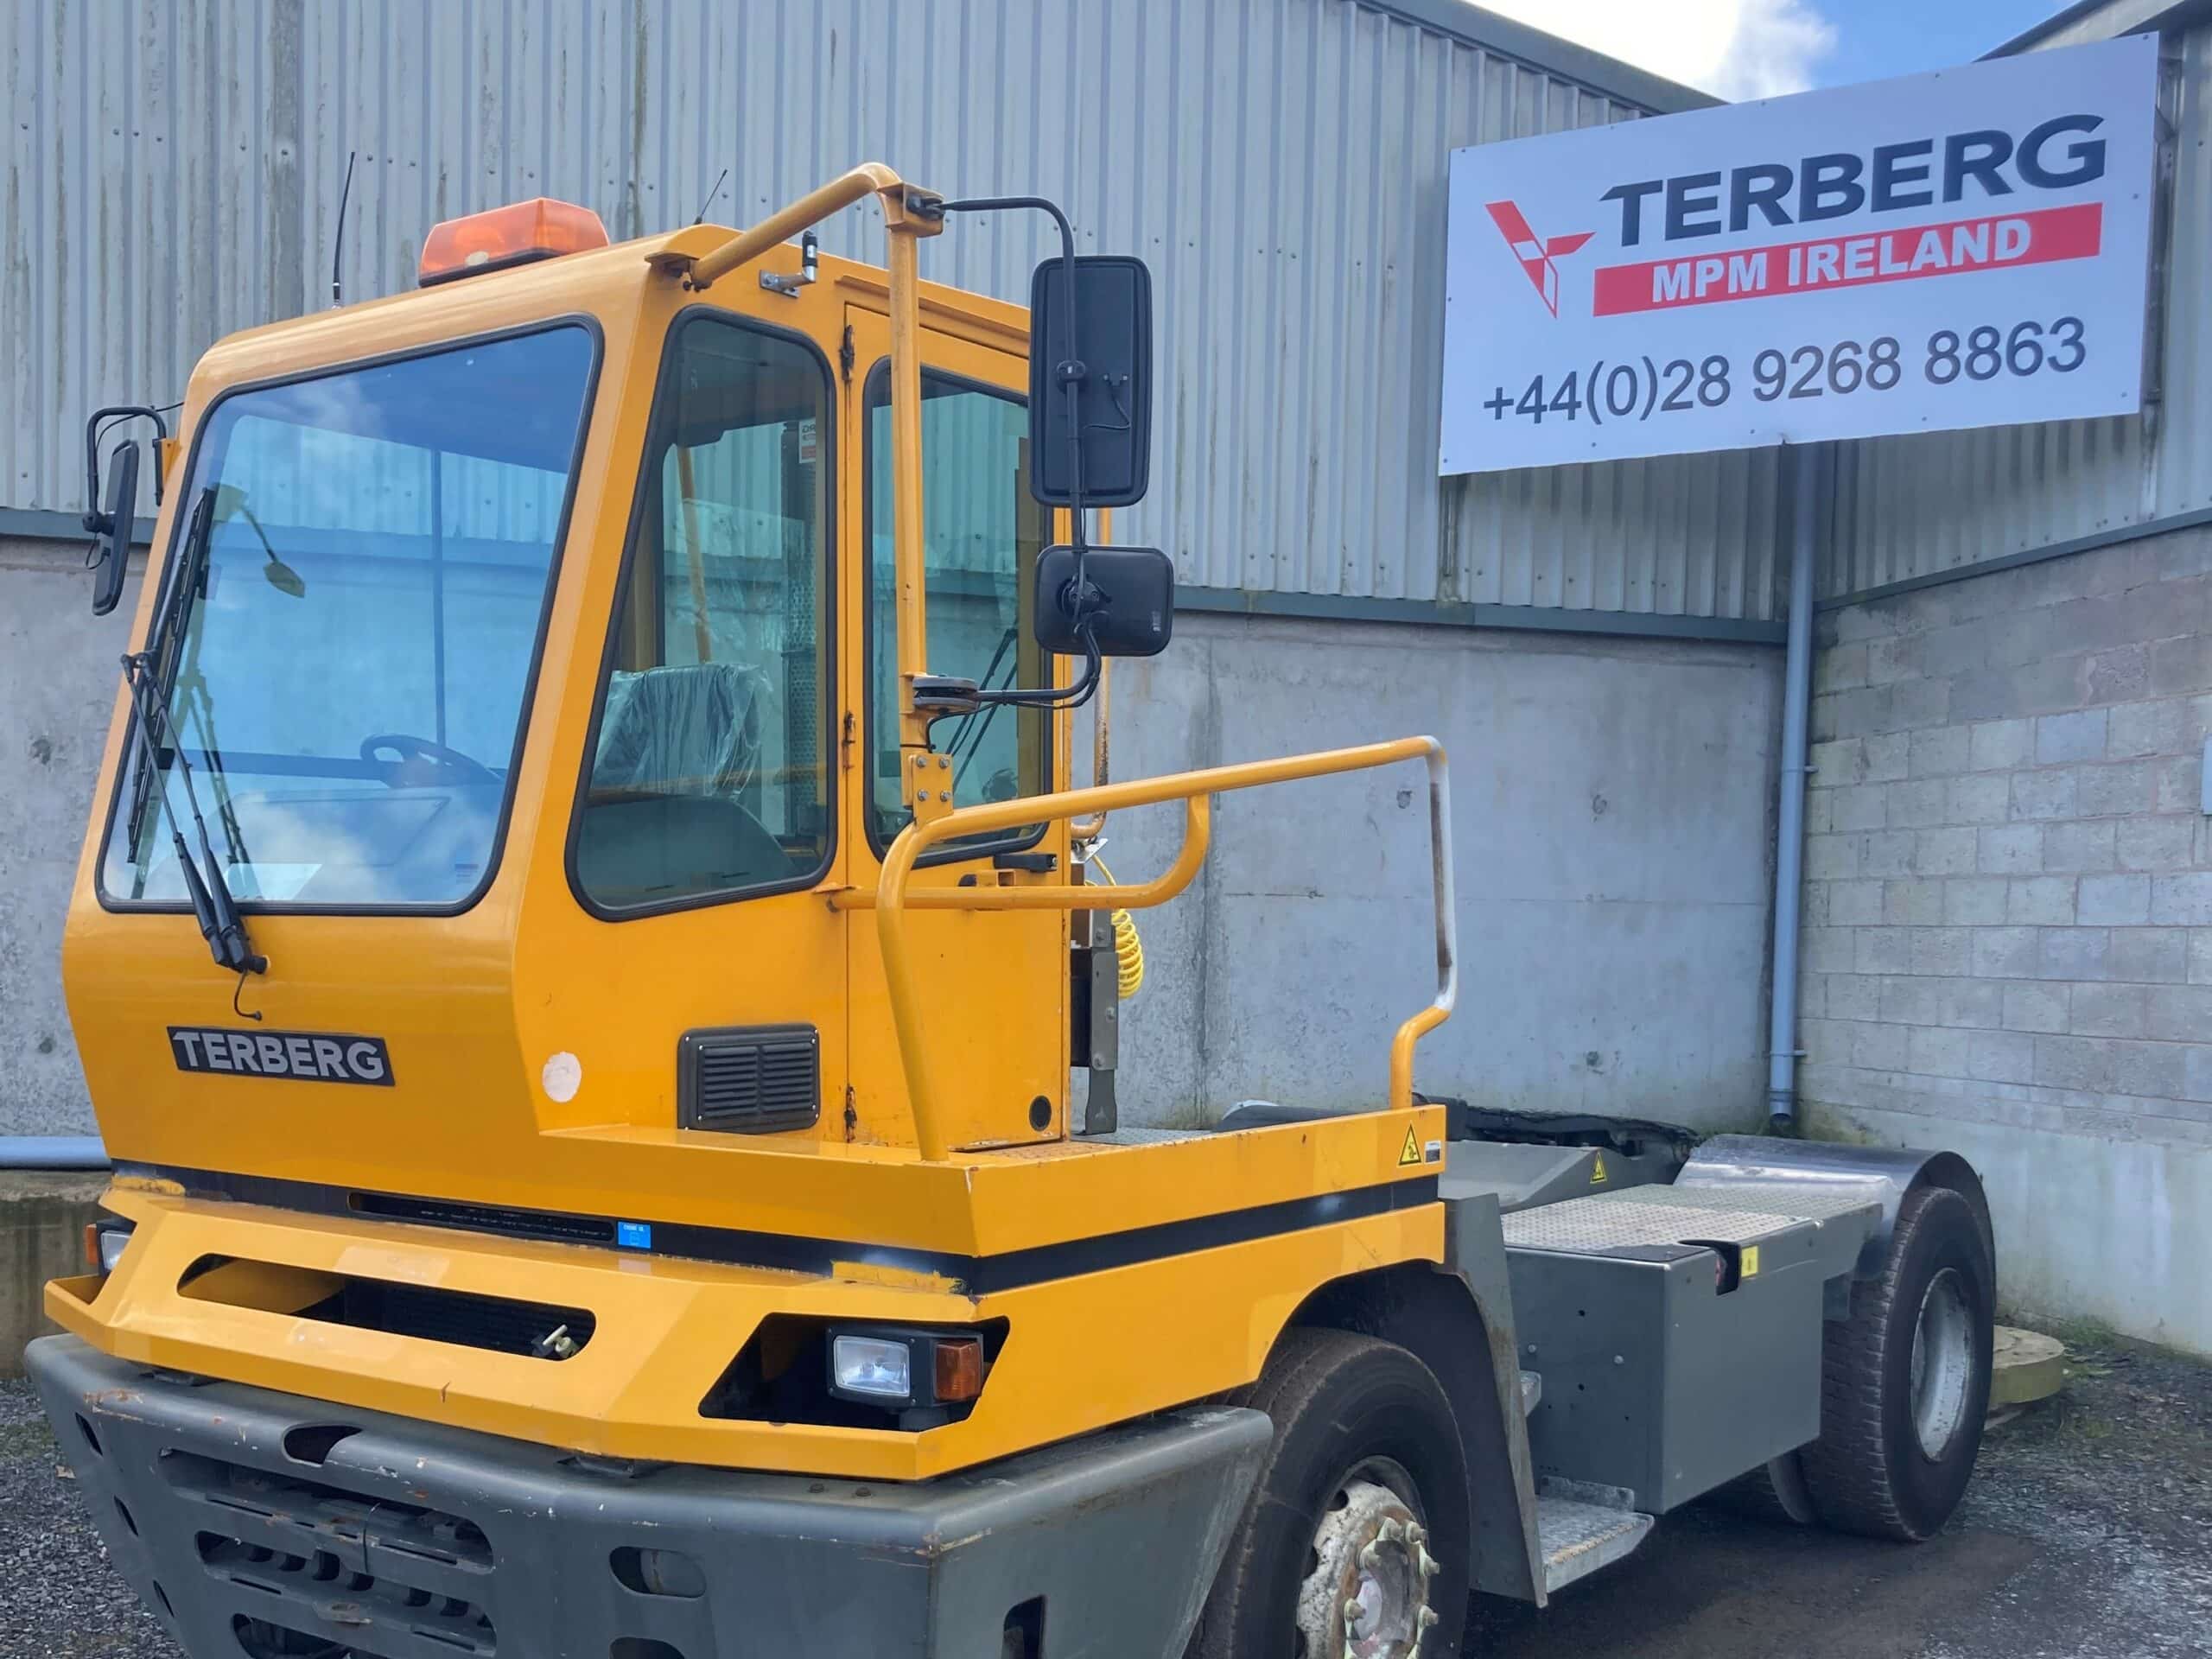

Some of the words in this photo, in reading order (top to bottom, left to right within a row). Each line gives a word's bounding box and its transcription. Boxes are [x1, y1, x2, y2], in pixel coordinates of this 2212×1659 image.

[1599, 113, 2107, 247] TERBERG
[1651, 252, 1768, 303] MPM
[1788, 218, 2033, 287] IRELAND
[1483, 354, 1731, 424] +44(0)28
[1752, 336, 1902, 402] 9268
[1924, 315, 2087, 385] 8863
[173, 1031, 385, 1080] TERBERG
